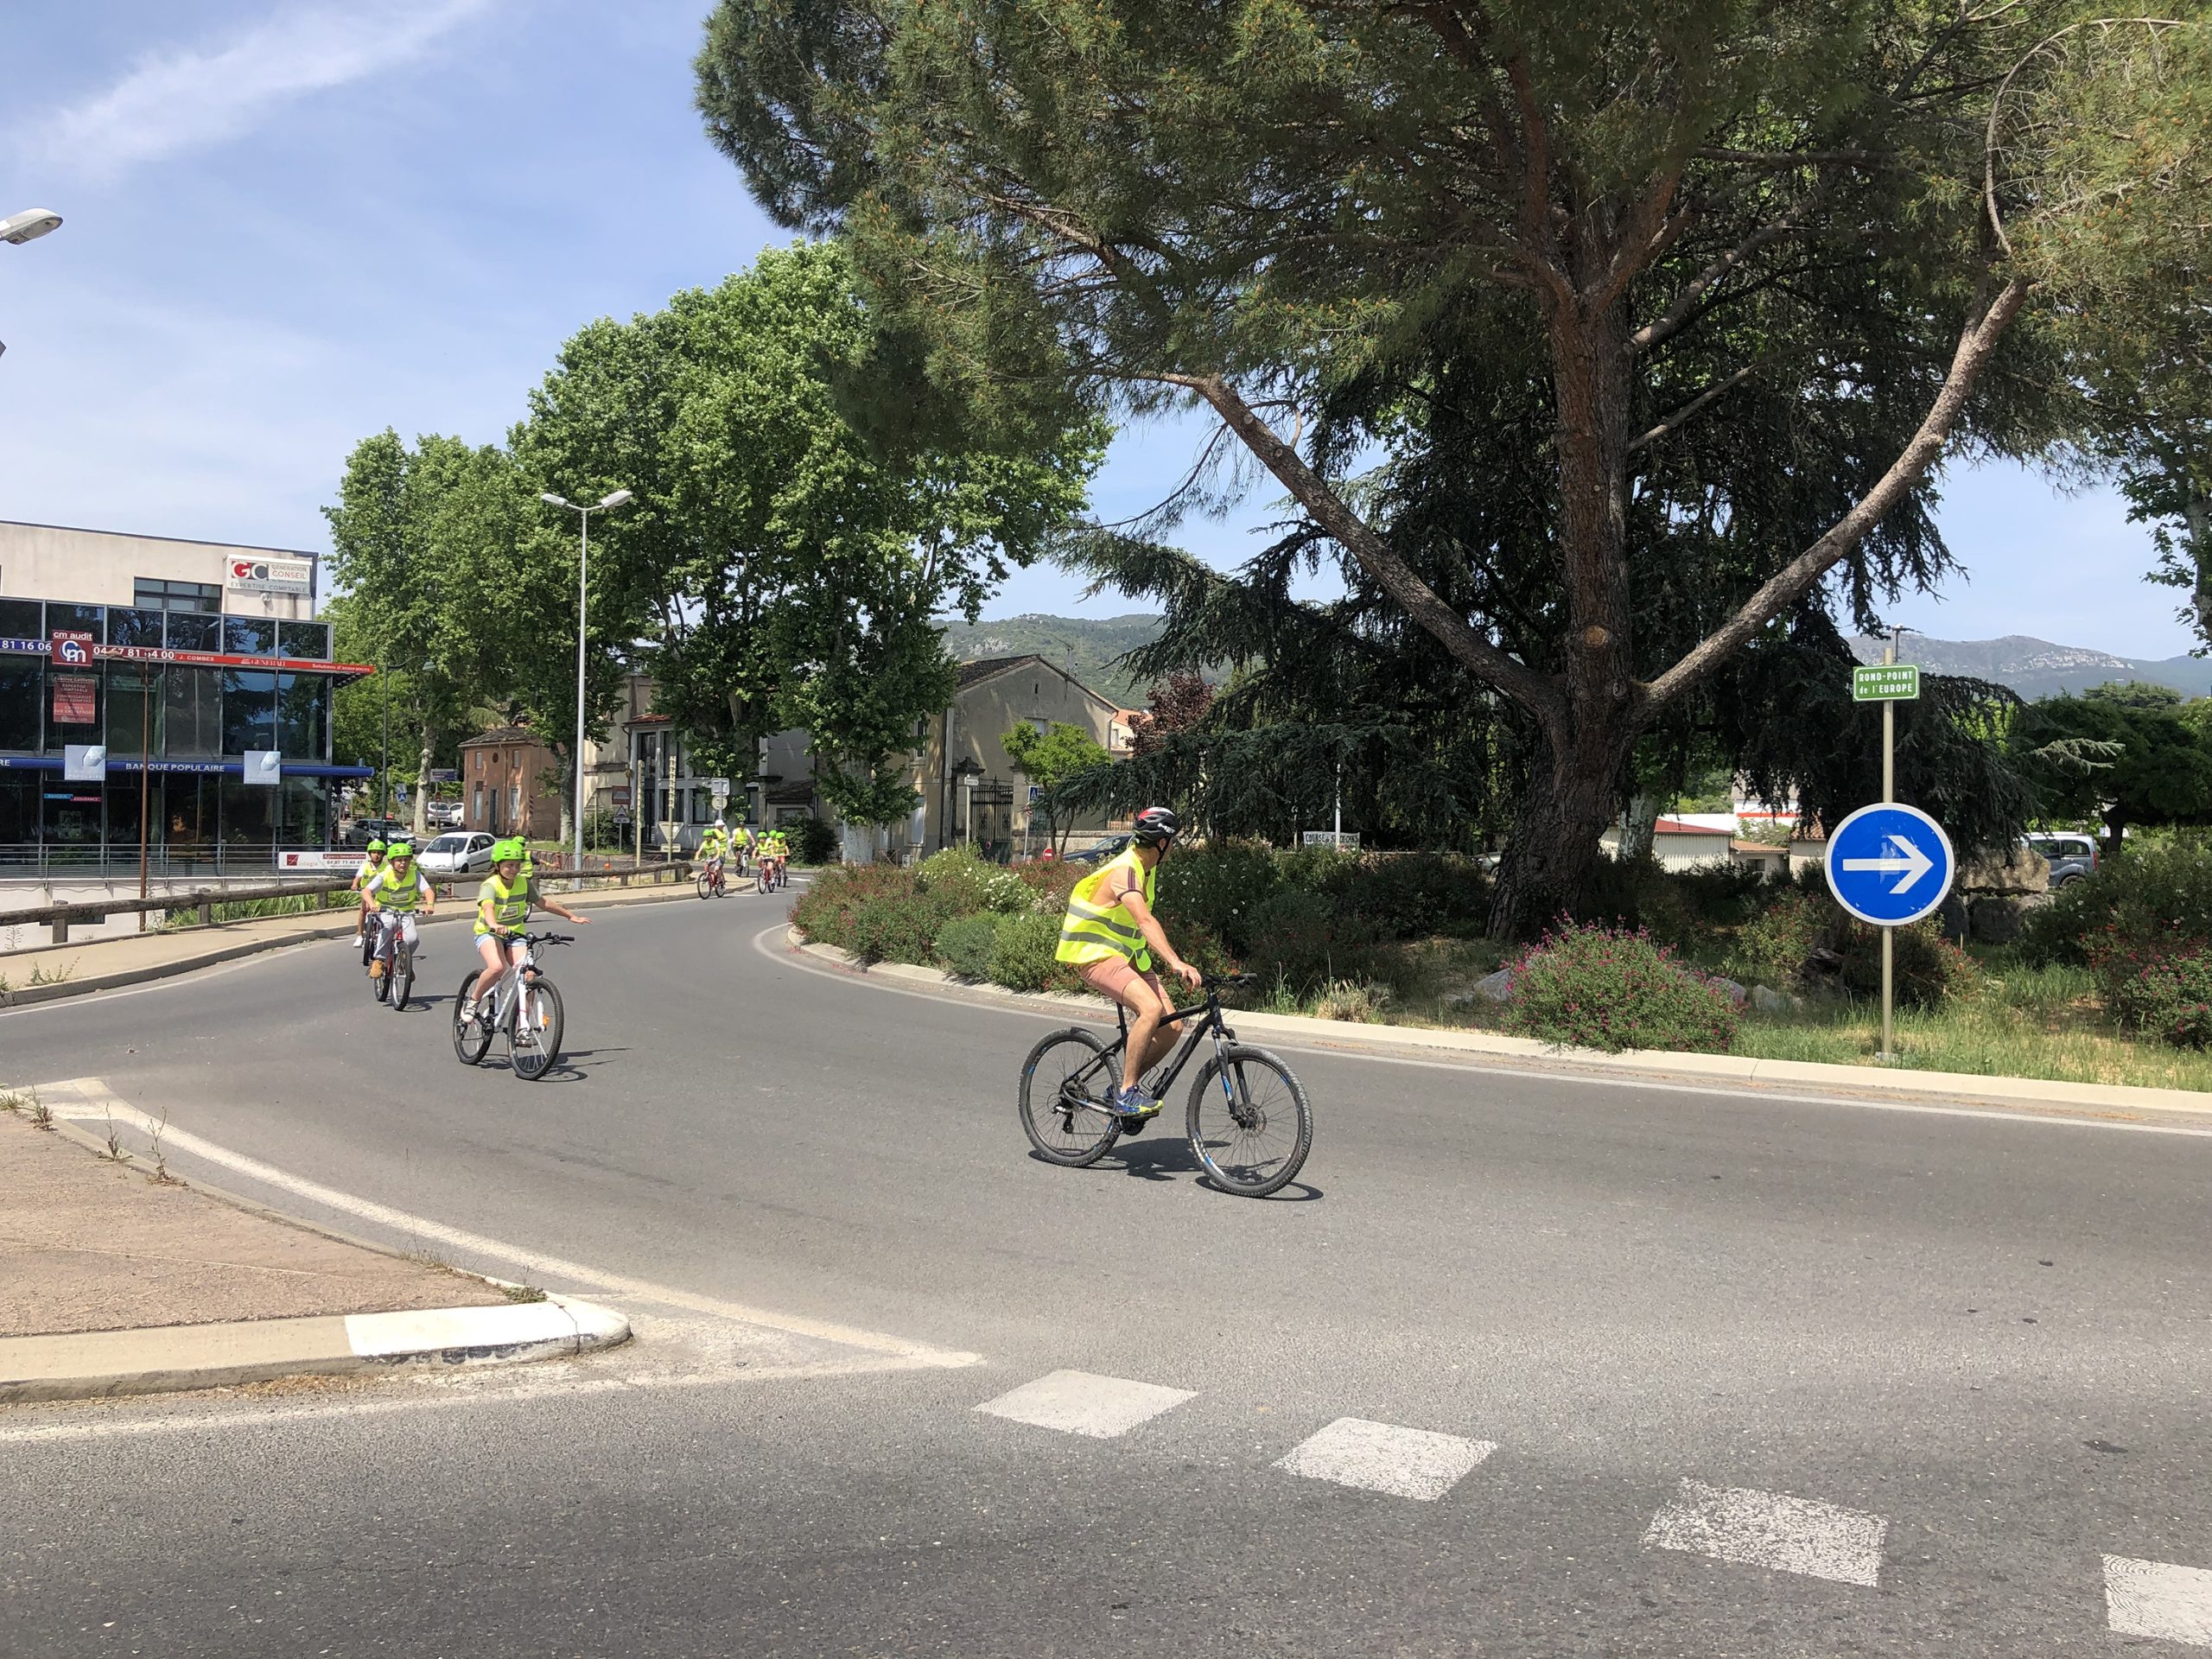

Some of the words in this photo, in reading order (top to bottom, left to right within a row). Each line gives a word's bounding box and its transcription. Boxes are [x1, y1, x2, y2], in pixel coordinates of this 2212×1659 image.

[232, 560, 269, 581] GC
[272, 570, 306, 579] CONSEIL
[2, 640, 15, 649] 81
[21, 641, 35, 650] 16
[38, 642, 52, 651] 06
[93, 646, 106, 655] 04
[128, 648, 140, 657] 81
[161, 651, 175, 659] 00
[1859, 671, 1913, 682] ROND-POINT
[1859, 685, 1868, 694] de
[1872, 683, 1913, 694] l'EUROPE
[126, 763, 169, 772] BANQUE
[171, 764, 226, 772] POPULAIRE
